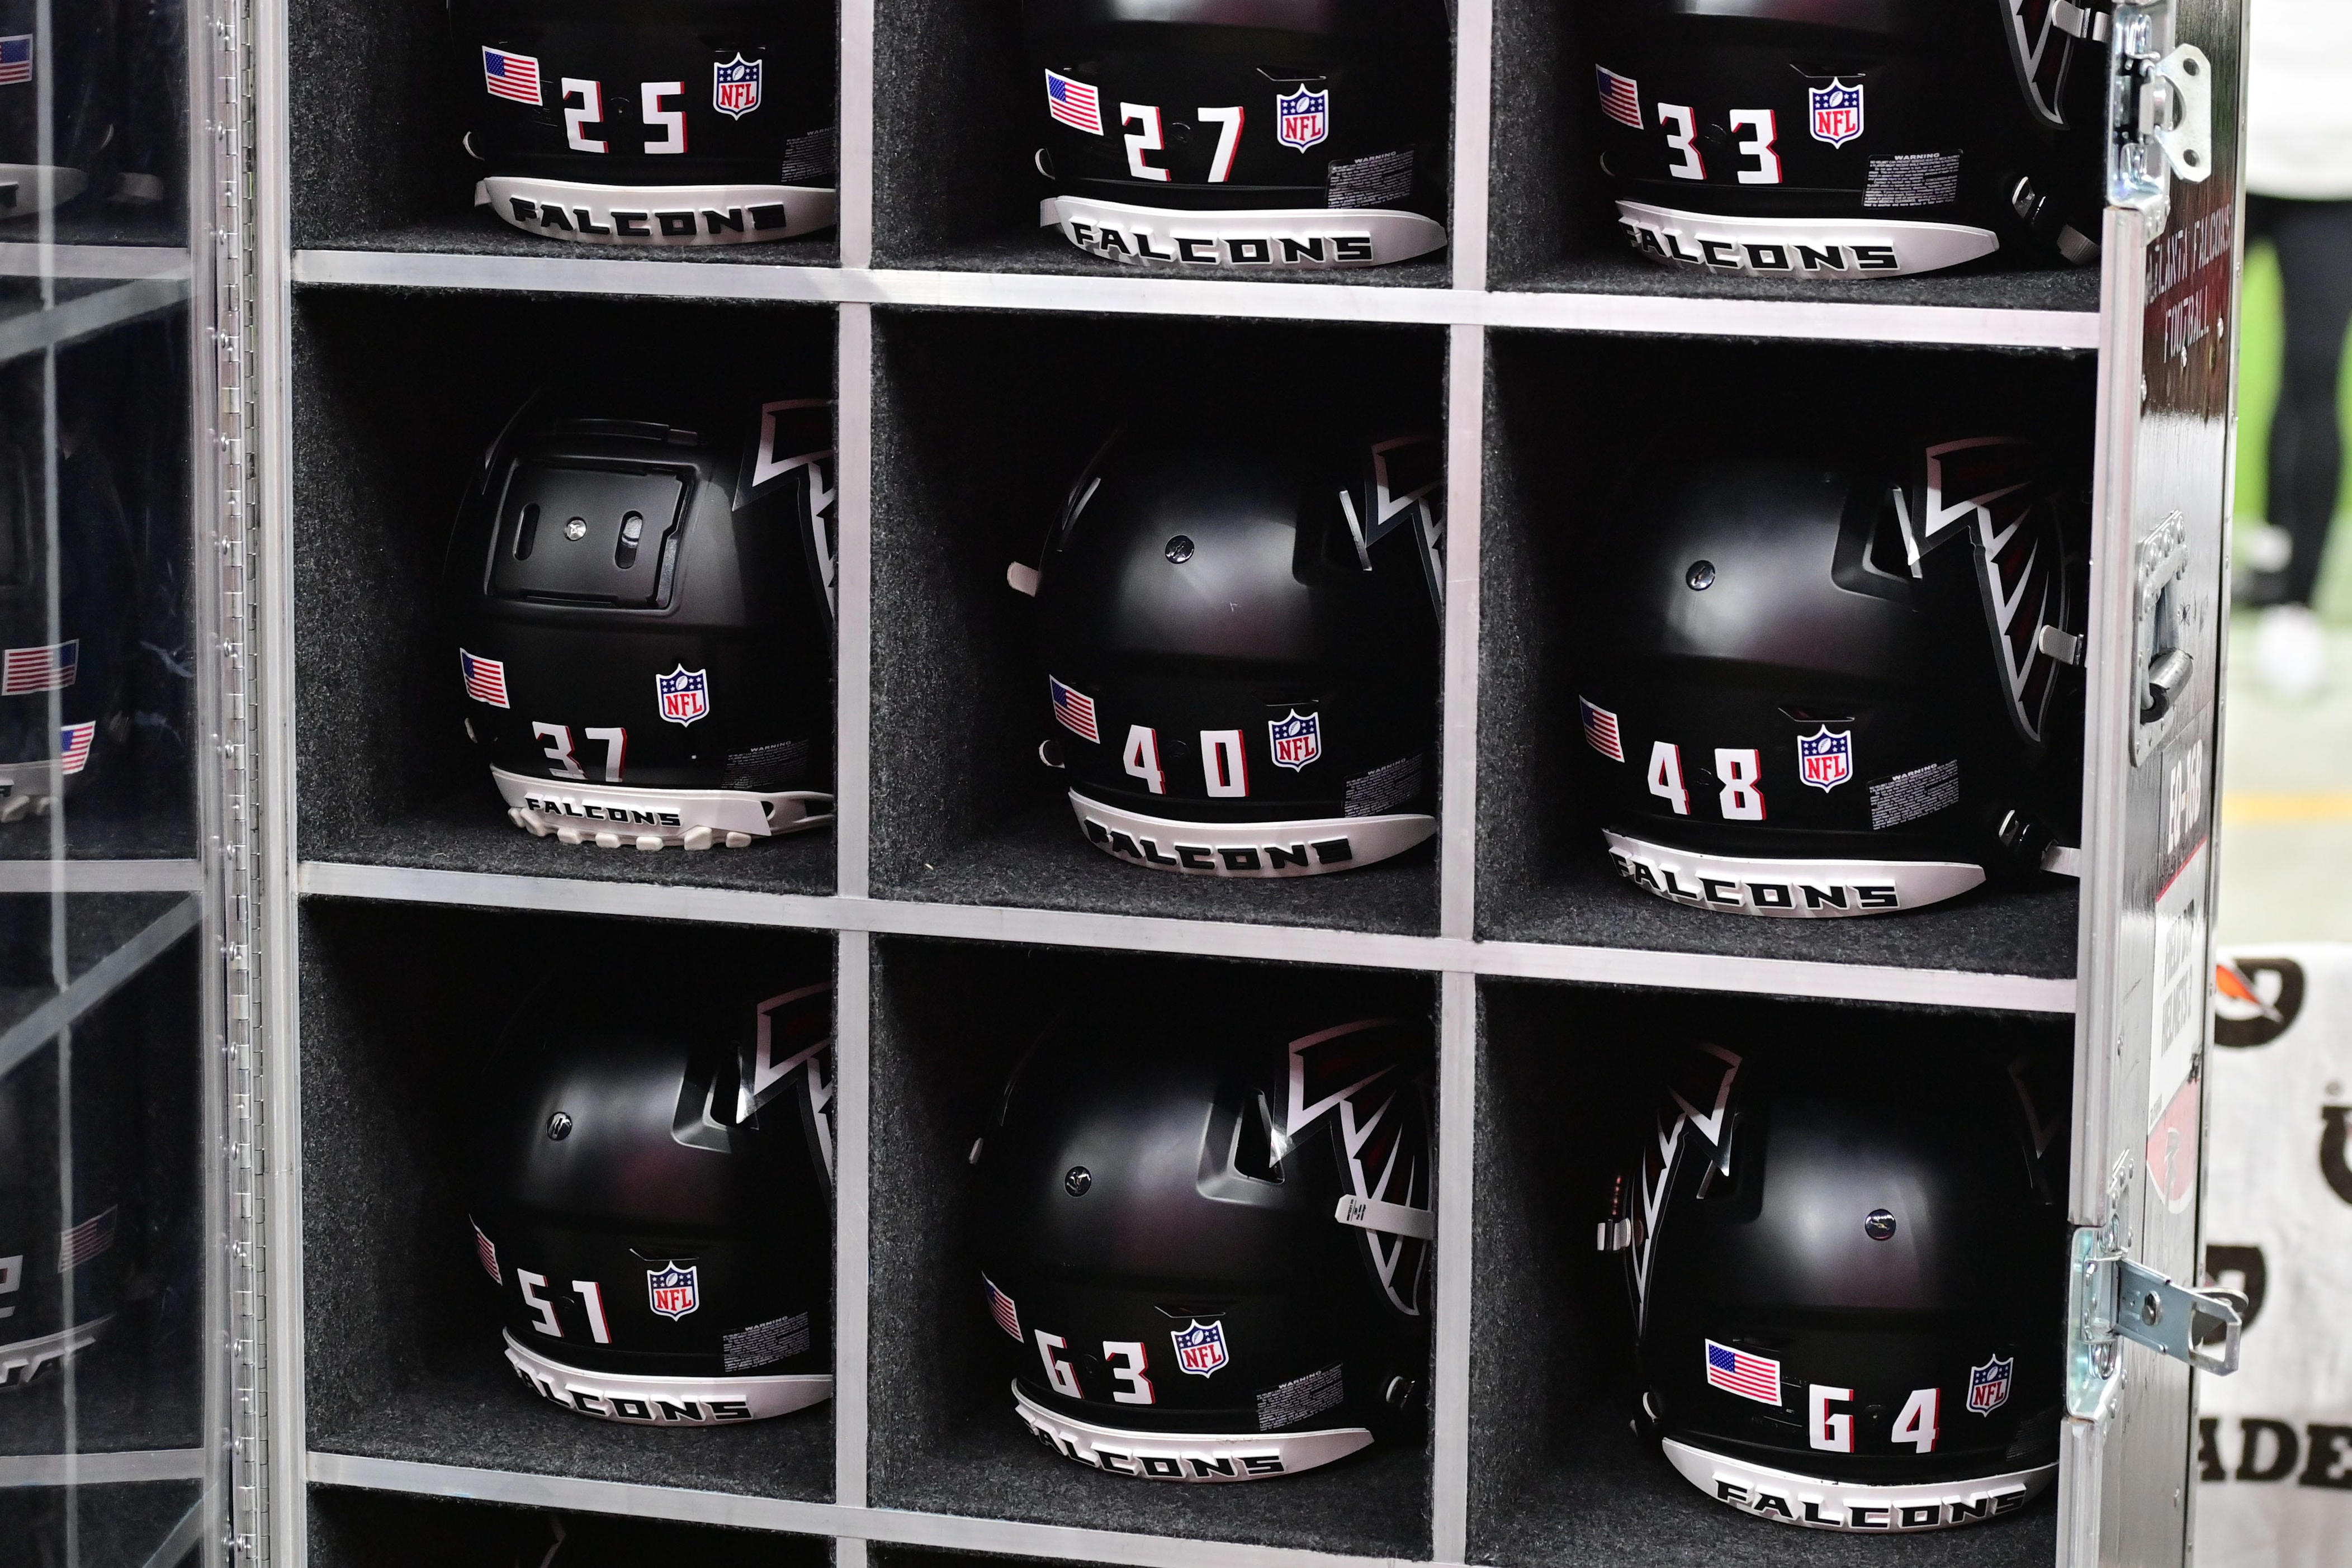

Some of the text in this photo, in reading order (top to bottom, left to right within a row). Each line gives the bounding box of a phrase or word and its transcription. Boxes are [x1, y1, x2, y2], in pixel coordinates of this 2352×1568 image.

[719, 82, 755, 109] NFL
[1285, 114, 1321, 141] NFL
[1818, 110, 1856, 135] NFL
[1354, 151, 1397, 164] WARNING
[509, 197, 786, 236] FALCONS
[1069, 218, 1373, 264] FALCONS
[1619, 218, 1900, 271] FALCONS
[2193, 203, 2231, 273] FALCONS
[2164, 285, 2209, 364] FOOTBALL
[666, 693, 702, 717] NFL
[532, 721, 627, 783] 37
[750, 740, 792, 752] WARNING
[1277, 737, 1315, 761] NFL
[1367, 757, 1406, 775] WARNING
[1806, 755, 1845, 781] NFL
[1892, 763, 1938, 781] WARNING
[524, 794, 683, 827] FALCONS
[1609, 847, 1901, 910] FALCONS
[655, 1288, 692, 1310] NFL
[745, 1315, 788, 1331] WARNING
[1183, 1343, 1222, 1371] NFL
[505, 1348, 754, 1421] ALCONS
[1278, 1370, 1322, 1389] WARNING
[1972, 1378, 2006, 1407] NFL
[1712, 1473, 2027, 1528] FALCONS
